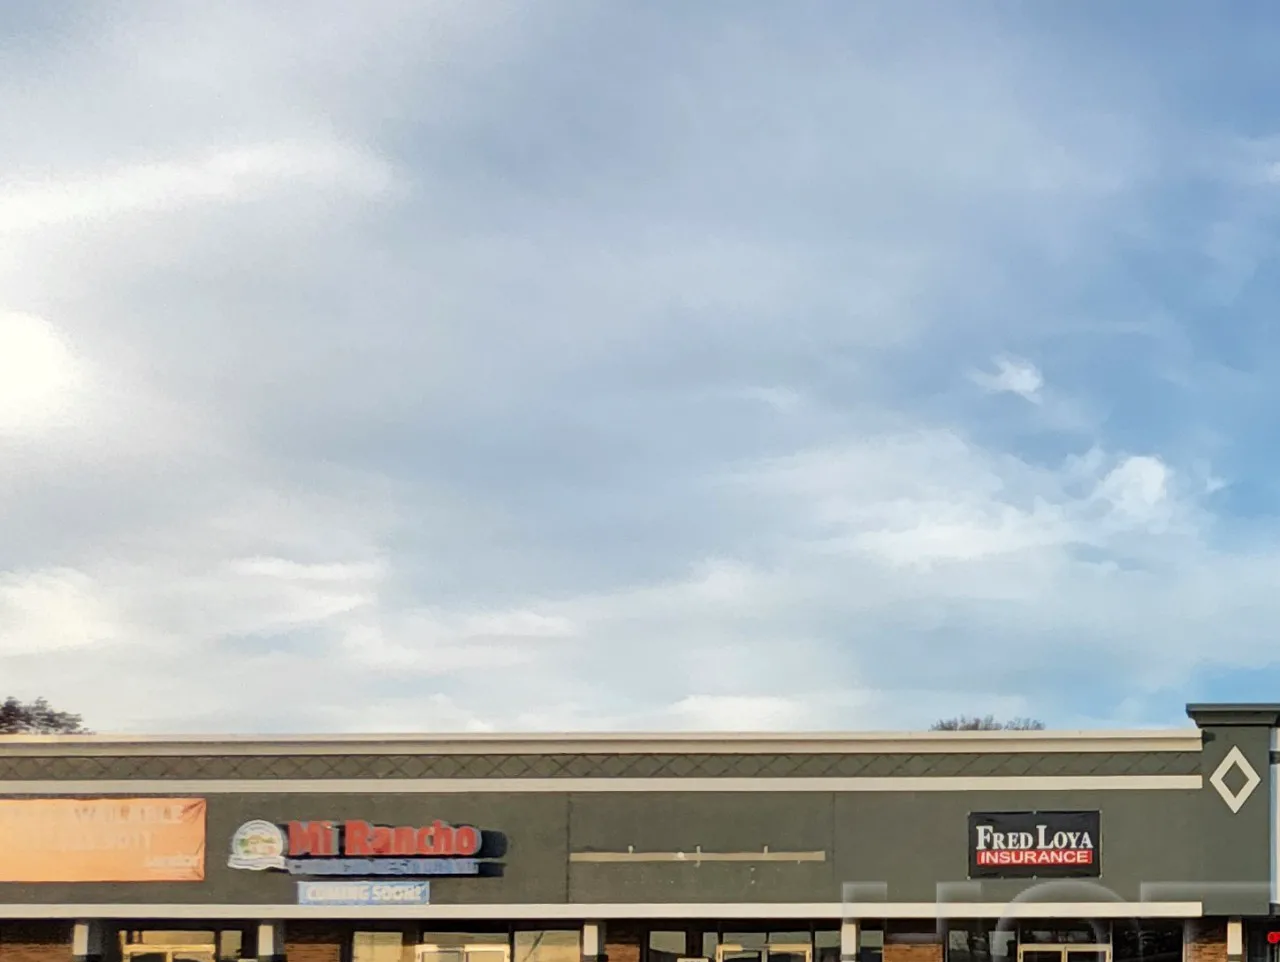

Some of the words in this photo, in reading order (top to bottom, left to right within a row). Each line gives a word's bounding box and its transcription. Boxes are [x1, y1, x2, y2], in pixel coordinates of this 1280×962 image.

[287, 820, 334, 856] Mi
[344, 819, 480, 856] Rancho
[975, 825, 1034, 850] FRED
[1035, 824, 1094, 849] LOYA
[980, 850, 1090, 864] INSURANCE
